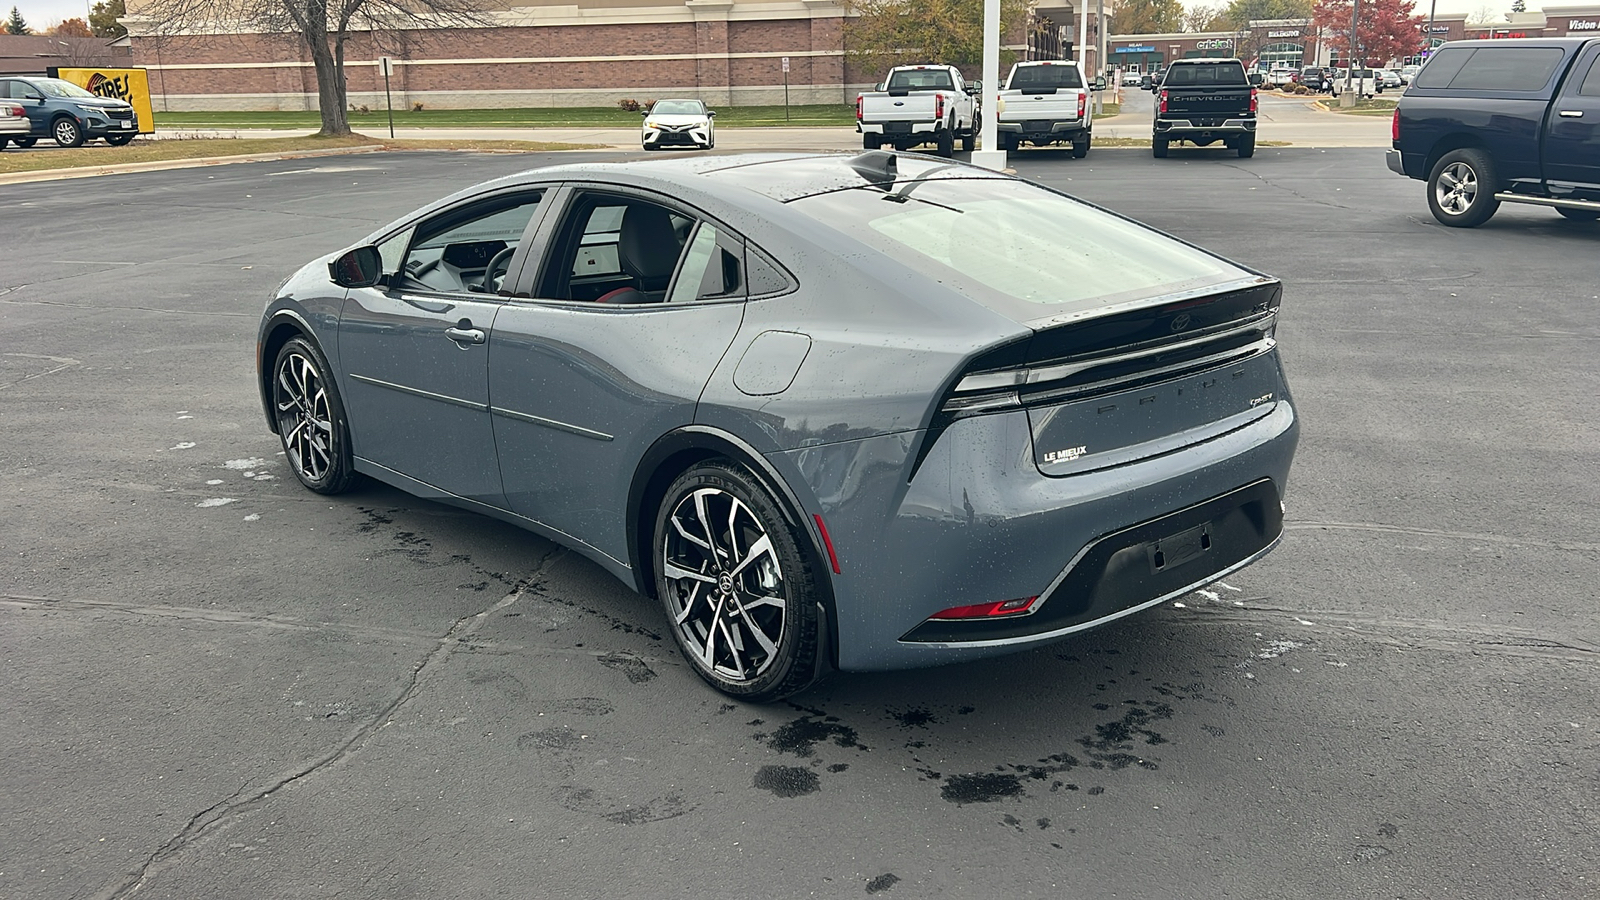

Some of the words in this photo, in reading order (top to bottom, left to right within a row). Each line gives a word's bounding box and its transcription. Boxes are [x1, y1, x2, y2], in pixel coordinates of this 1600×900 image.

[1569, 19, 1596, 30] Vision
[1196, 38, 1233, 50] cricket
[93, 72, 130, 99] TIRES
[1044, 451, 1056, 462] LE
[1057, 445, 1087, 459] MIEUX
